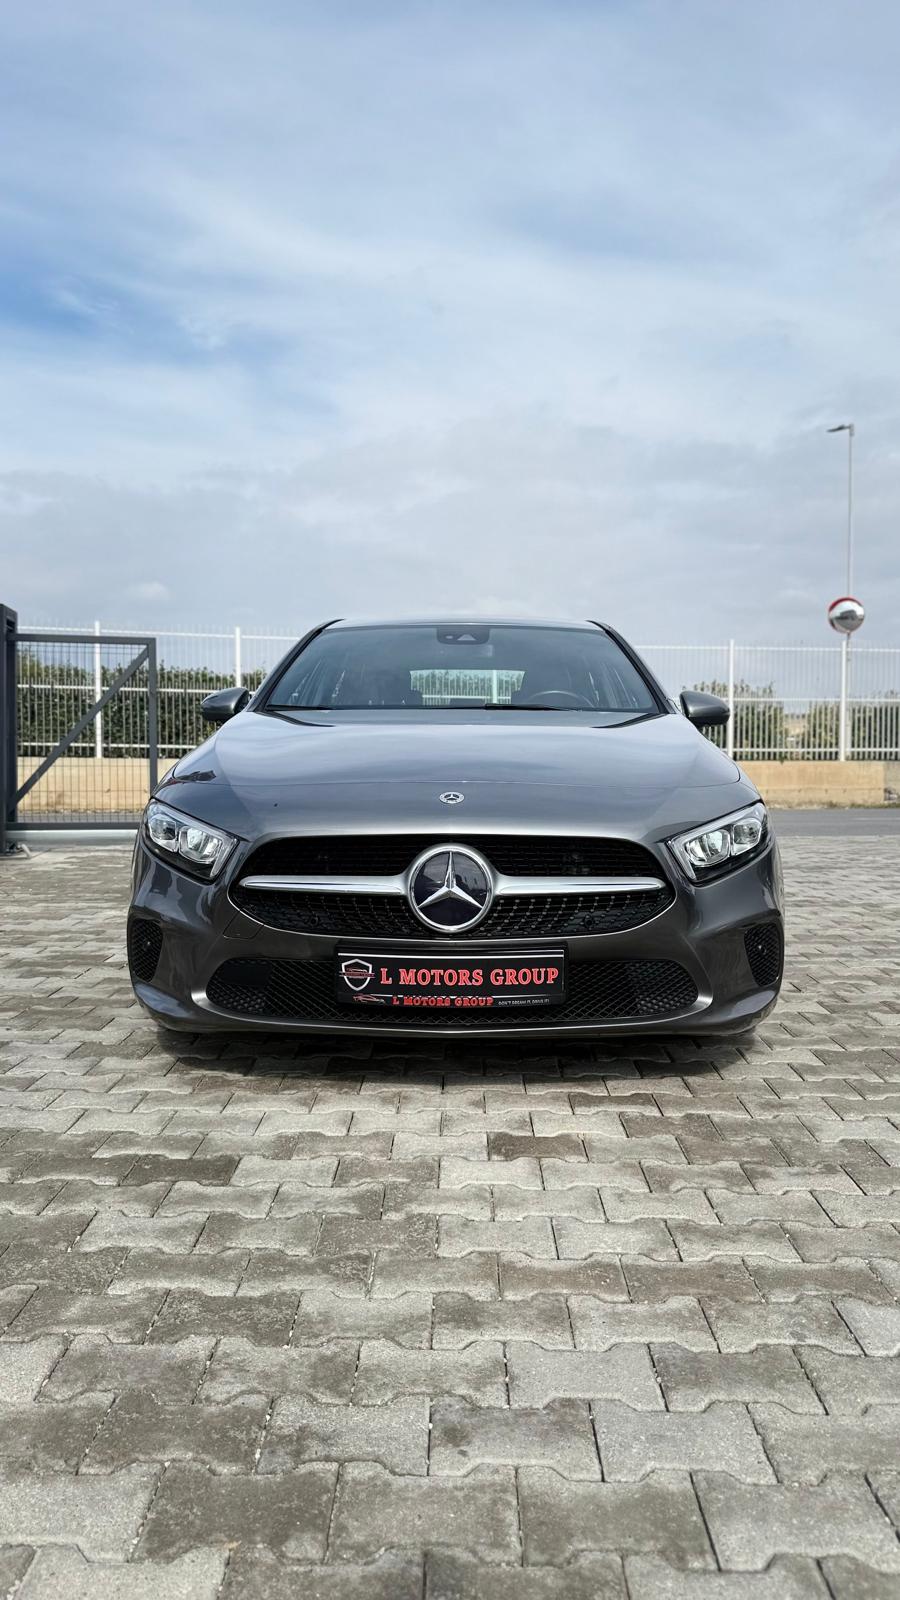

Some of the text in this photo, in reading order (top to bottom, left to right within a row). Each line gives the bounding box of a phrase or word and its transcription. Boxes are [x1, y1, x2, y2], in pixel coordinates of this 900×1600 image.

[380, 967, 559, 986] L MOTORS GROUP
[392, 996, 494, 1007] L MOTORS GROUP
